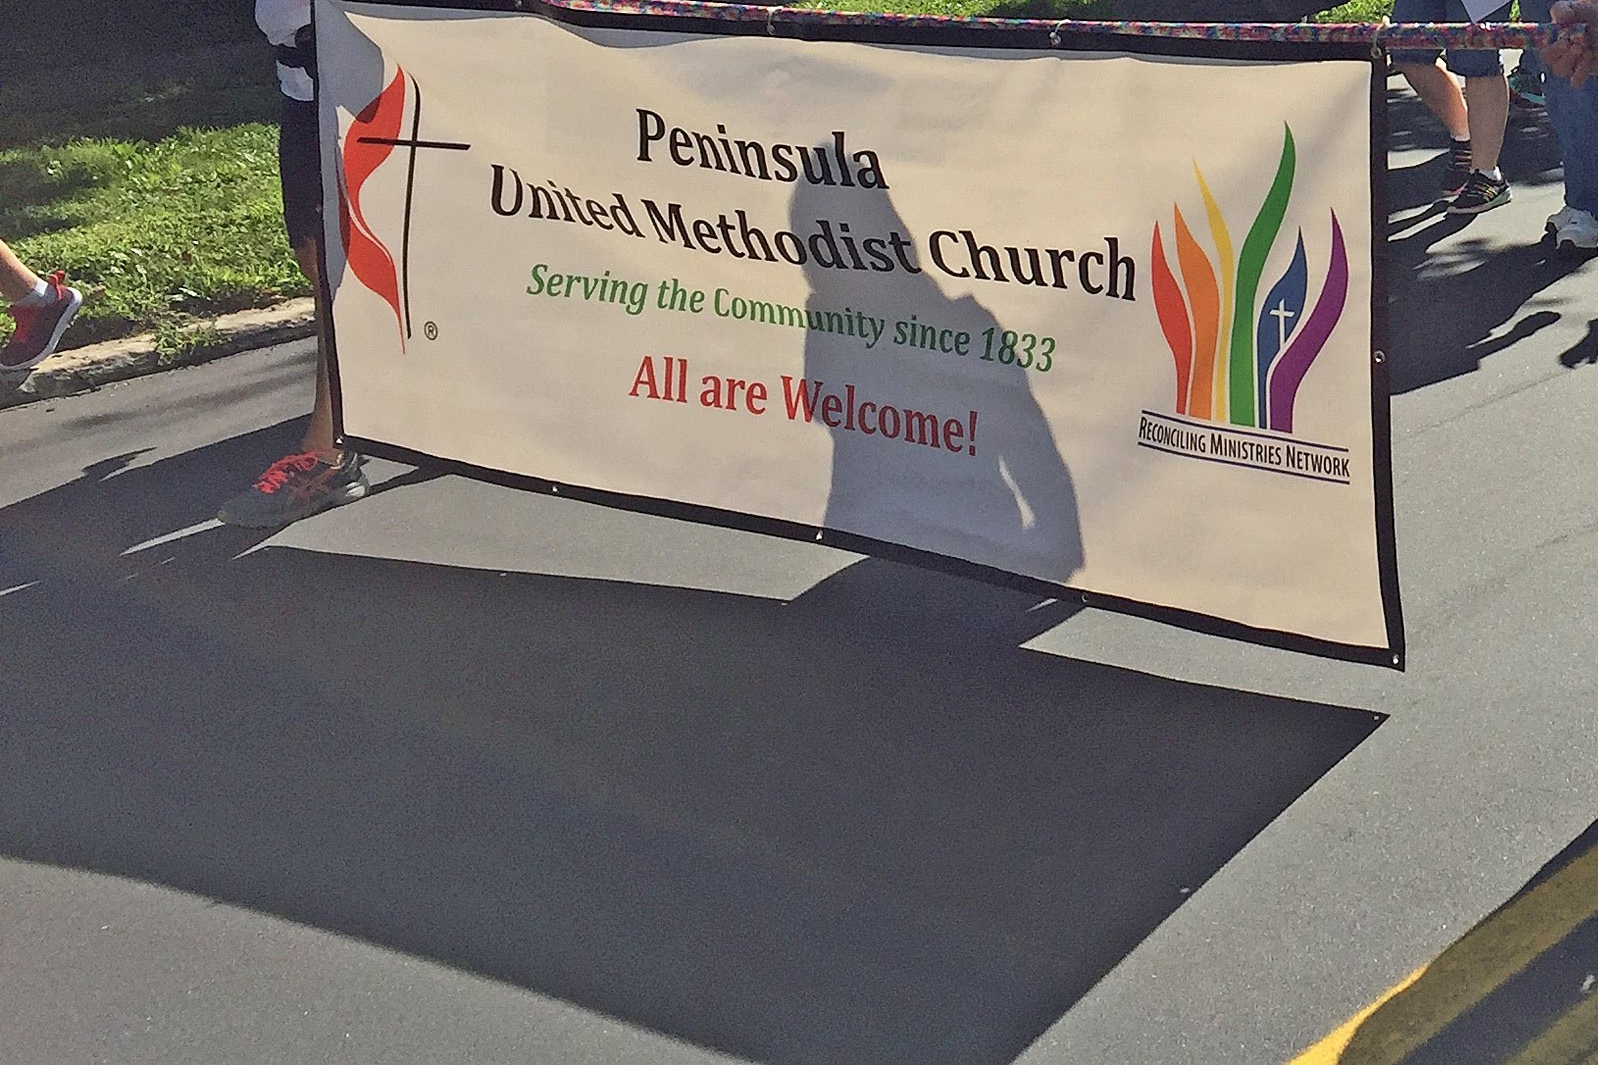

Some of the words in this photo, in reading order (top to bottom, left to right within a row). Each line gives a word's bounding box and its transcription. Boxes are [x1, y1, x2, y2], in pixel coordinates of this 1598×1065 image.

[636, 108, 889, 190] Peninsula
[489, 164, 645, 237] United
[640, 198, 922, 275] Methodist
[929, 230, 1136, 302] Church
[526, 263, 649, 315] Serving
[656, 278, 704, 313] the
[713, 288, 885, 349] Community
[893, 314, 971, 356] since
[979, 326, 1056, 373] 1833
[629, 355, 688, 403] All
[700, 373, 768, 415] are
[781, 375, 978, 457] Welcome!
[1139, 416, 1206, 453] RECONCILING
[1210, 433, 1282, 466] MINISTRIES
[1286, 445, 1350, 477] NETWORK
